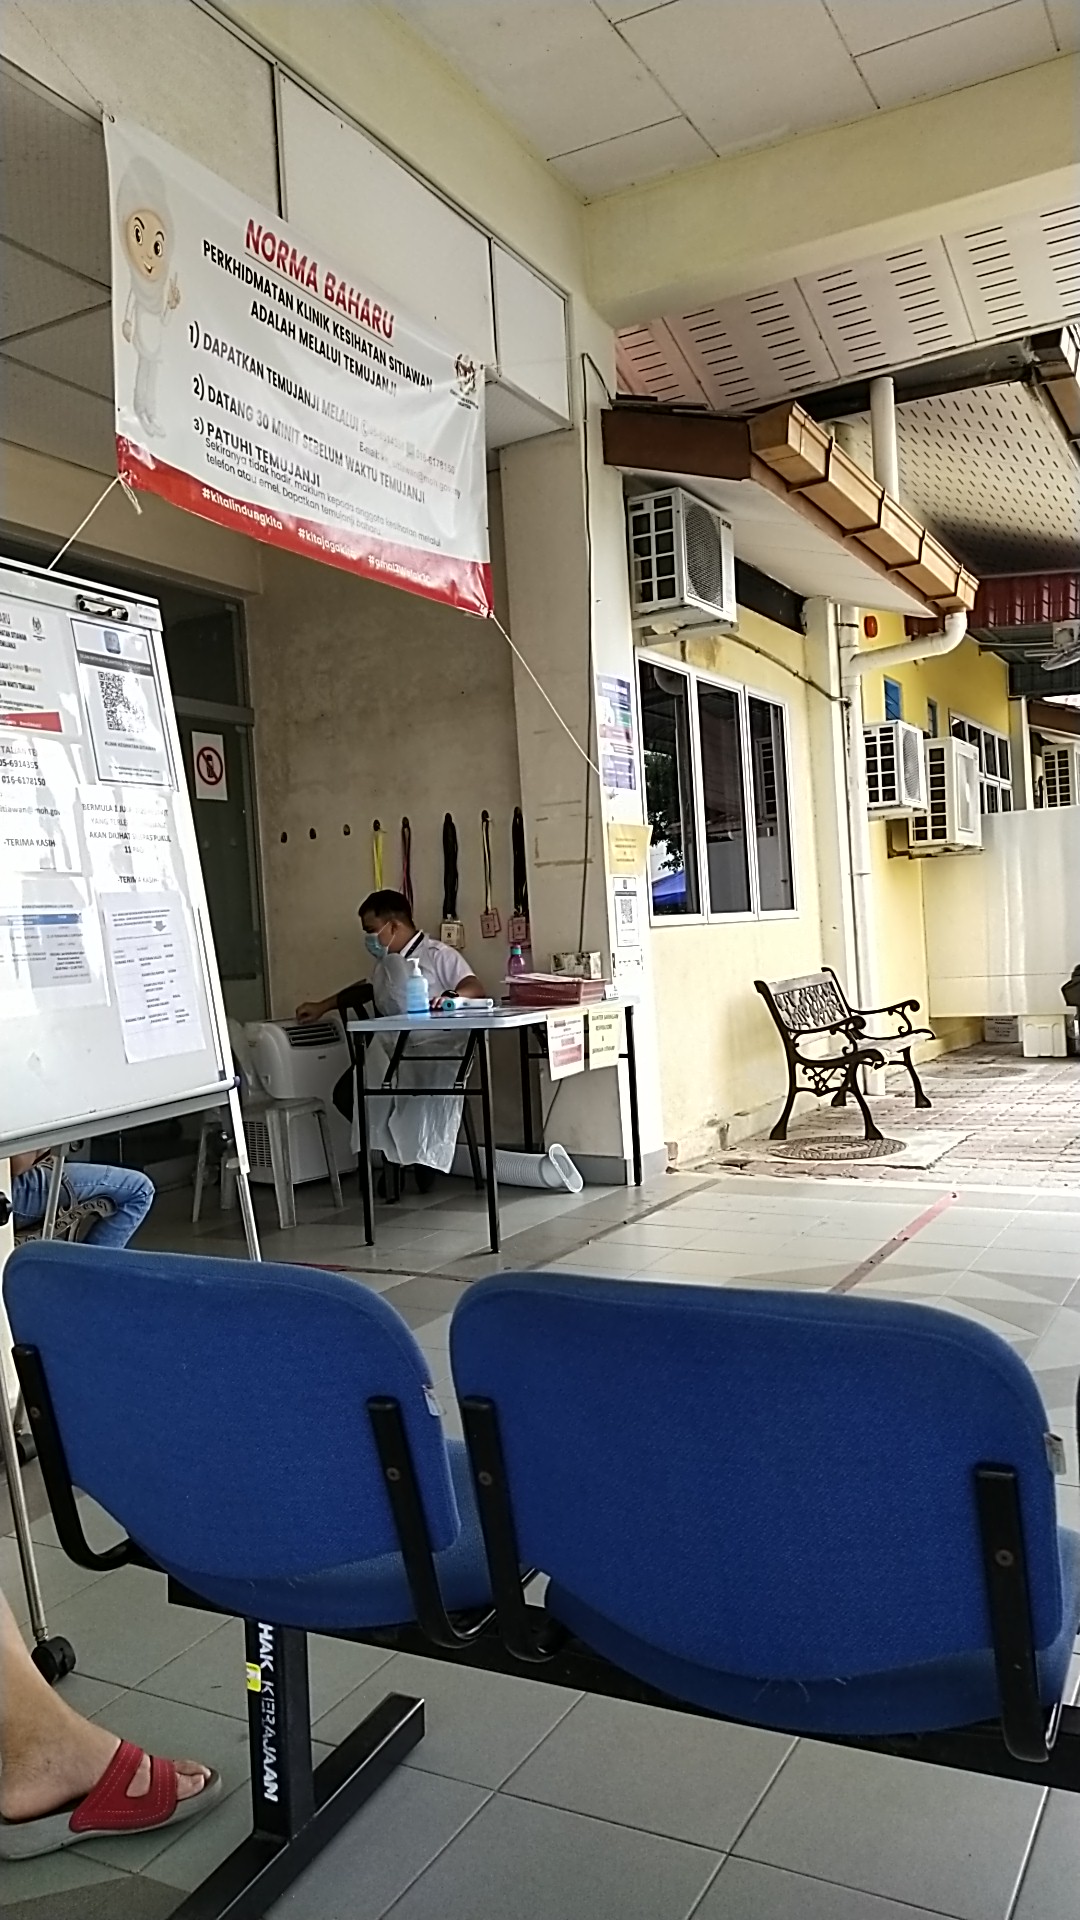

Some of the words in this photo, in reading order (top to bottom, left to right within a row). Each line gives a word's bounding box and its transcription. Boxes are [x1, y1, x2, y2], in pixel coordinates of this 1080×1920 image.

[203, 239, 294, 311] PERKHIDMATAN
[297, 299, 330, 332] KLINIK
[332, 321, 387, 367] KESIHATAN
[389, 355, 433, 392] SITIAWAN
[246, 218, 318, 293] NORMA
[324, 271, 395, 339] BAHARU
[189, 320, 200, 348] 1)
[203, 332, 264, 380] DAPATKAN
[266, 366, 319, 411] TEMUJANJI
[321, 399, 358, 432] MELALUI
[250, 301, 296, 340] ADALAH
[299, 327, 341, 366] MELALUI
[344, 353, 397, 397] TEMUJANJI
[193, 373, 205, 401] 2)
[208, 385, 254, 422] DATANG
[256, 409, 269, 430] 30
[272, 418, 300, 446] MINIT
[302, 433, 343, 467] SEBELUM
[345, 454, 378, 482] WAKTU
[380, 471, 425, 504] TEMUJANJI
[193, 416, 205, 435] 3)
[207, 422, 253, 456] PATUHI
[255, 445, 321, 488] TEMUJANJI
[205, 437, 247, 466] Sekiranya
[248, 458, 270, 476] tidak
[206, 452, 236, 474] telefon
[237, 467, 257, 485] atau
[282, 487, 320, 511] Dapatkan
[201, 487, 283, 530] #kitalindungkita
[257, 1621, 275, 1673] HAK
[261, 1679, 279, 1803] KERAJAAN
